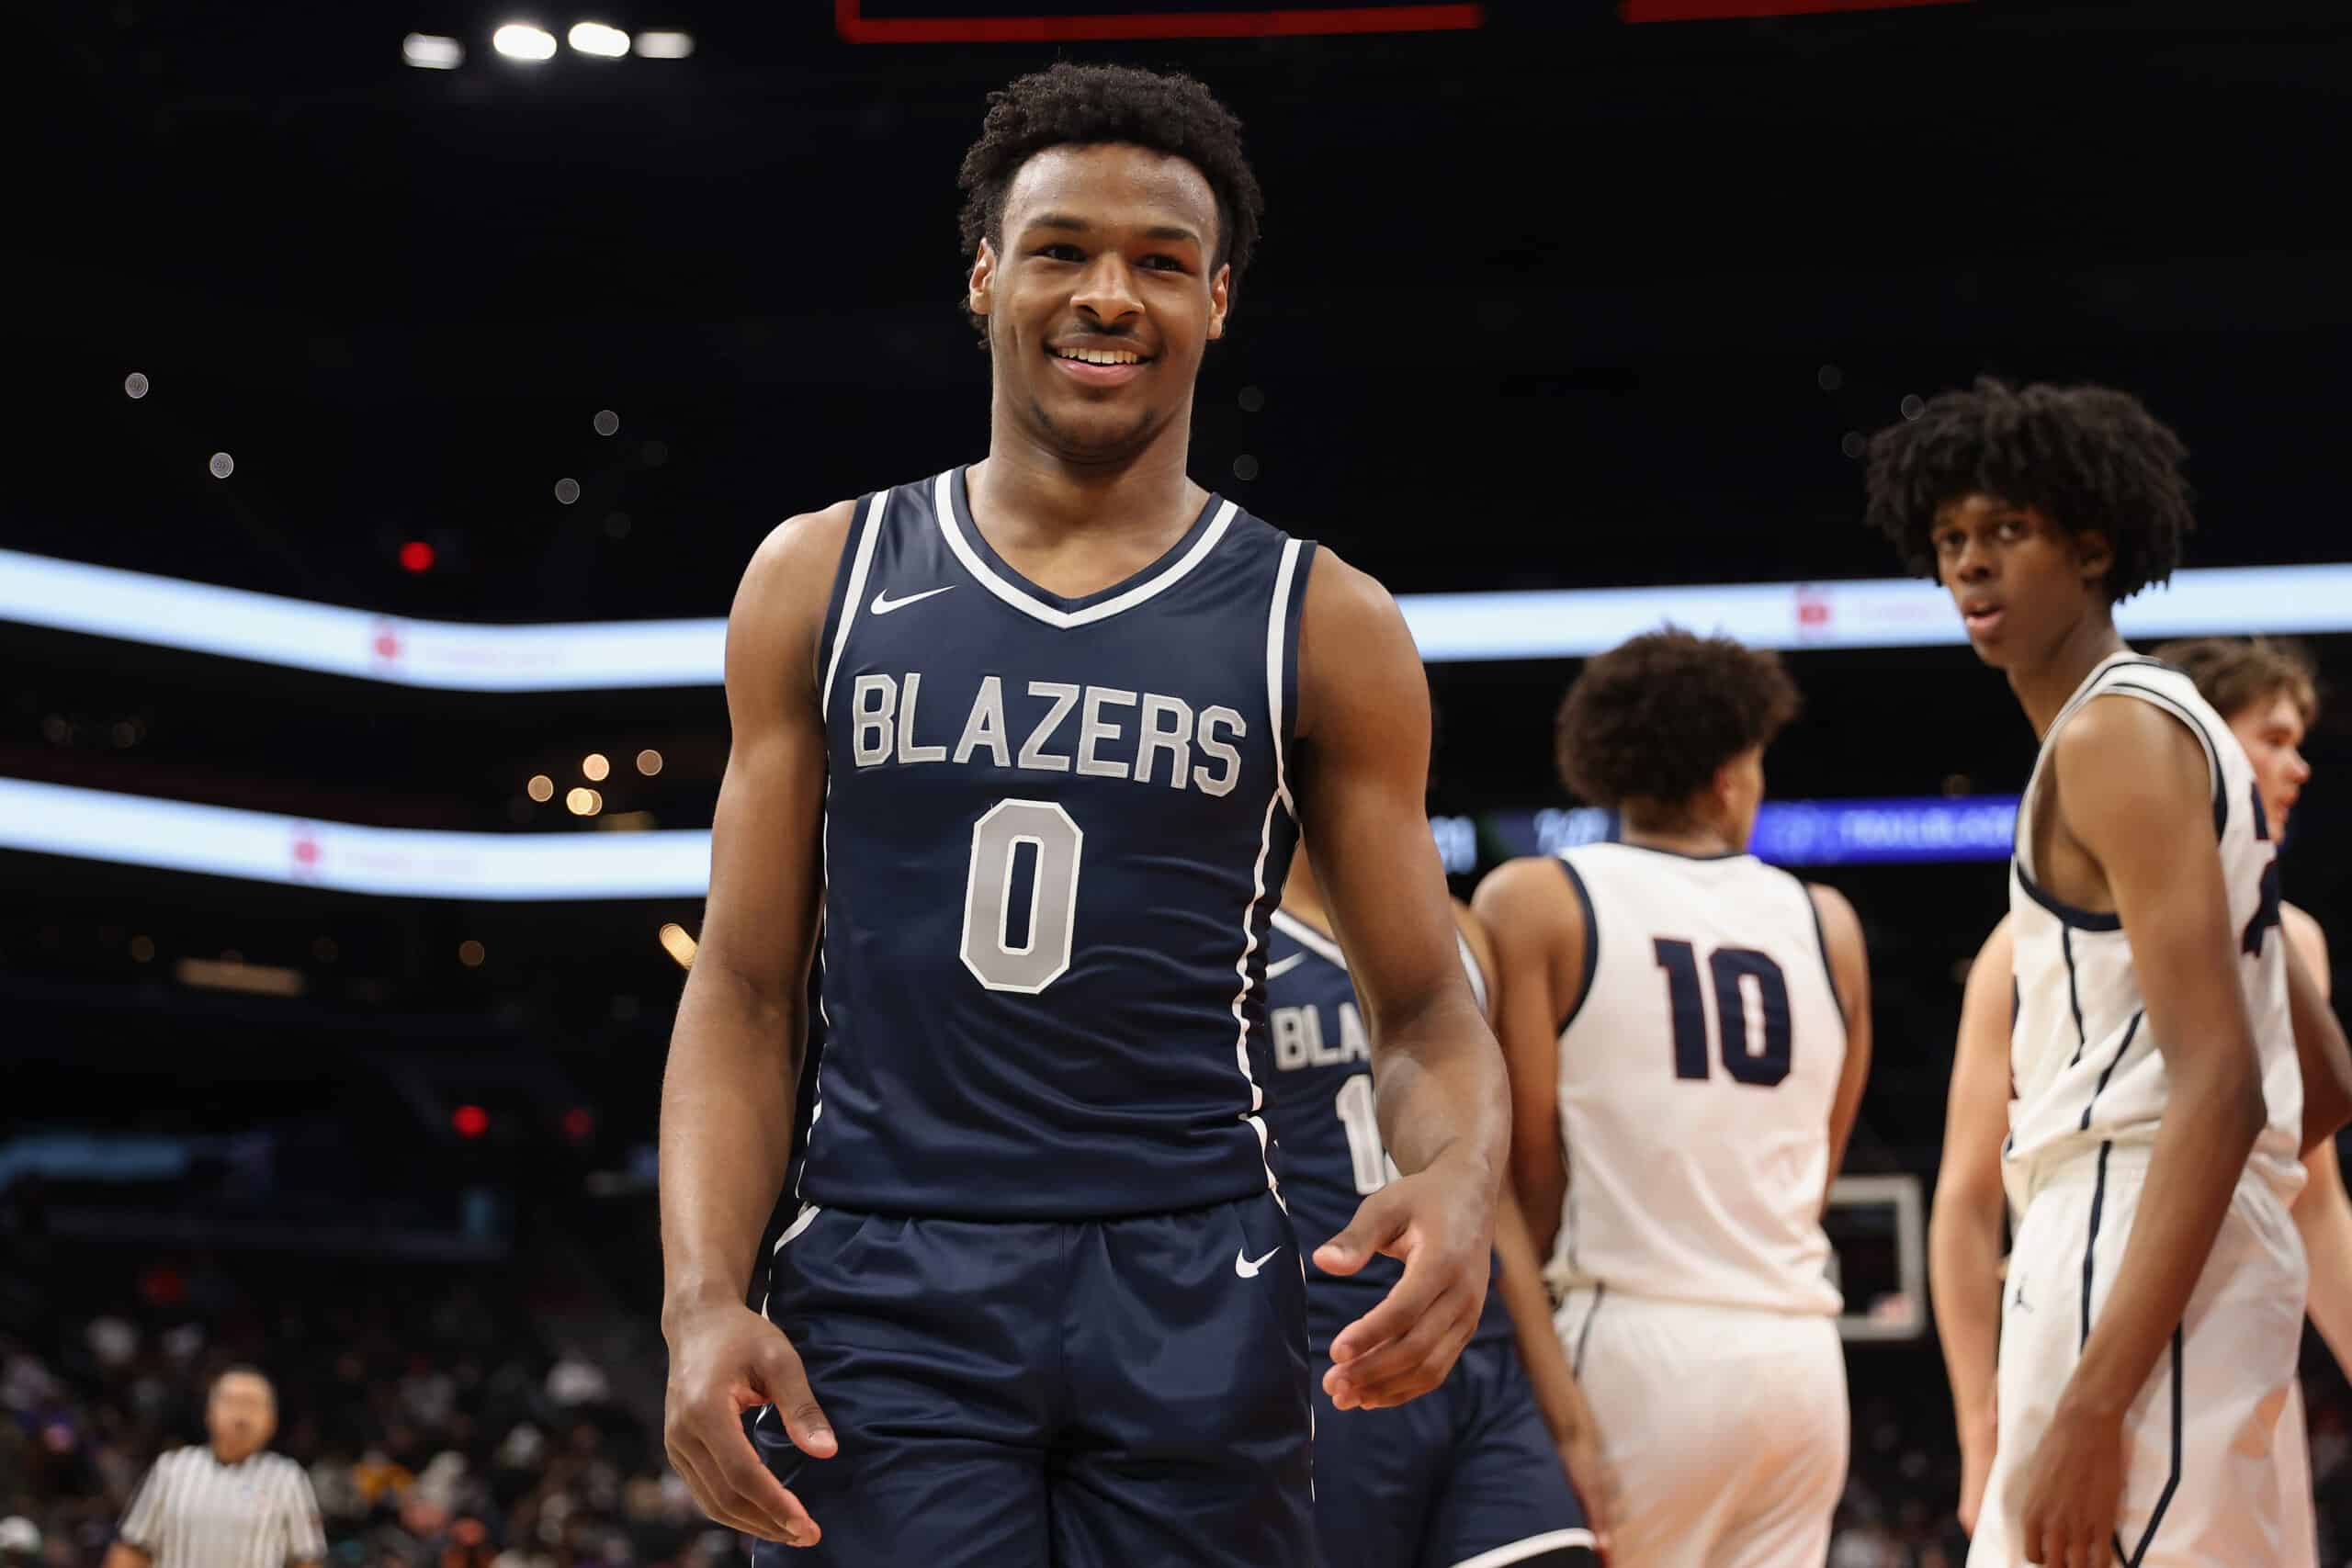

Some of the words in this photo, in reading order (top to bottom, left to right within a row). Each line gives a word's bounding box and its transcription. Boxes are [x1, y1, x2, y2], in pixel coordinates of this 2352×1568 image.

[853, 672, 1247, 796] BLAZERS
[959, 797, 1083, 994] 0
[1653, 937, 1792, 1087] 10
[1335, 1073, 1404, 1195] 1
